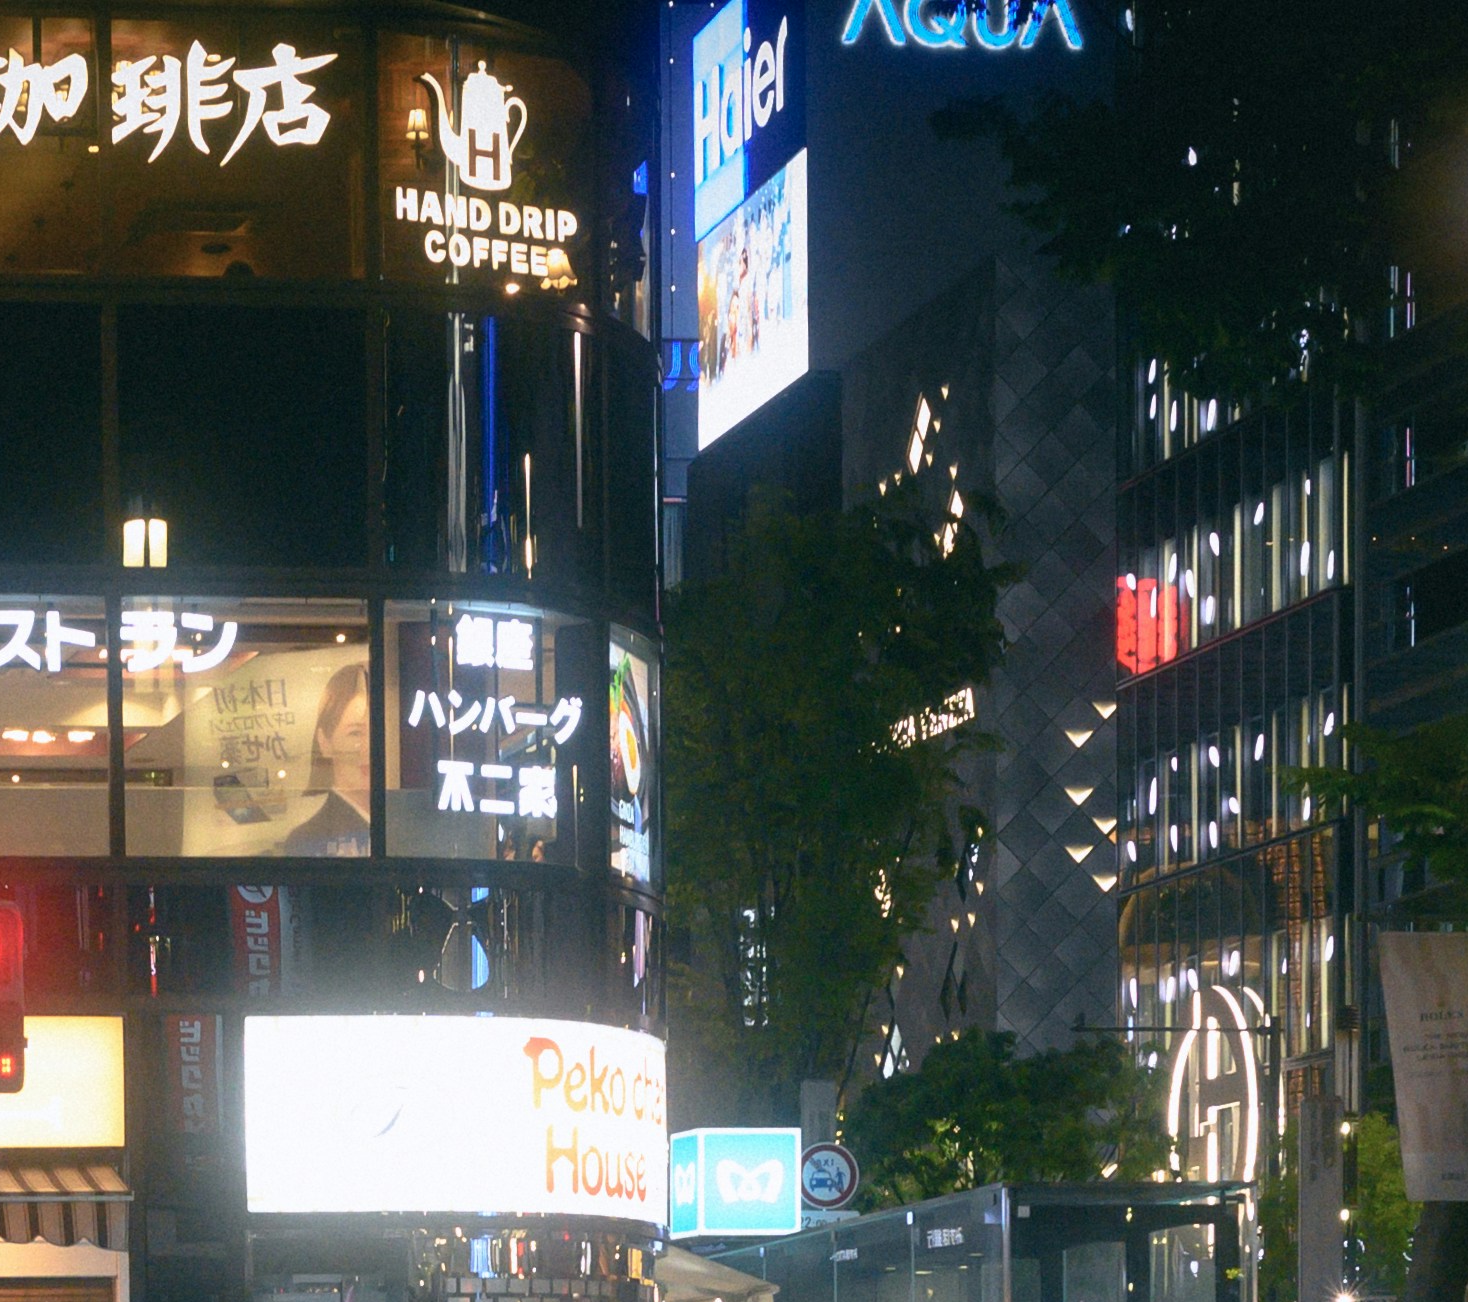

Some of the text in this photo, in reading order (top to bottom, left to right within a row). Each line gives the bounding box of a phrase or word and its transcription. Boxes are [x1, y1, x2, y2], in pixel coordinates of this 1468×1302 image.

[694, 16, 789, 187] Haier
[394, 186, 579, 242] HAND DRIP
[424, 234, 550, 278] COFFEE
[455, 613, 534, 671] 銀座
[407, 689, 583, 745] ハンバーグ
[437, 758, 558, 819] 不二家
[523, 1036, 626, 1117] Peko
[546, 1124, 647, 1203] House
